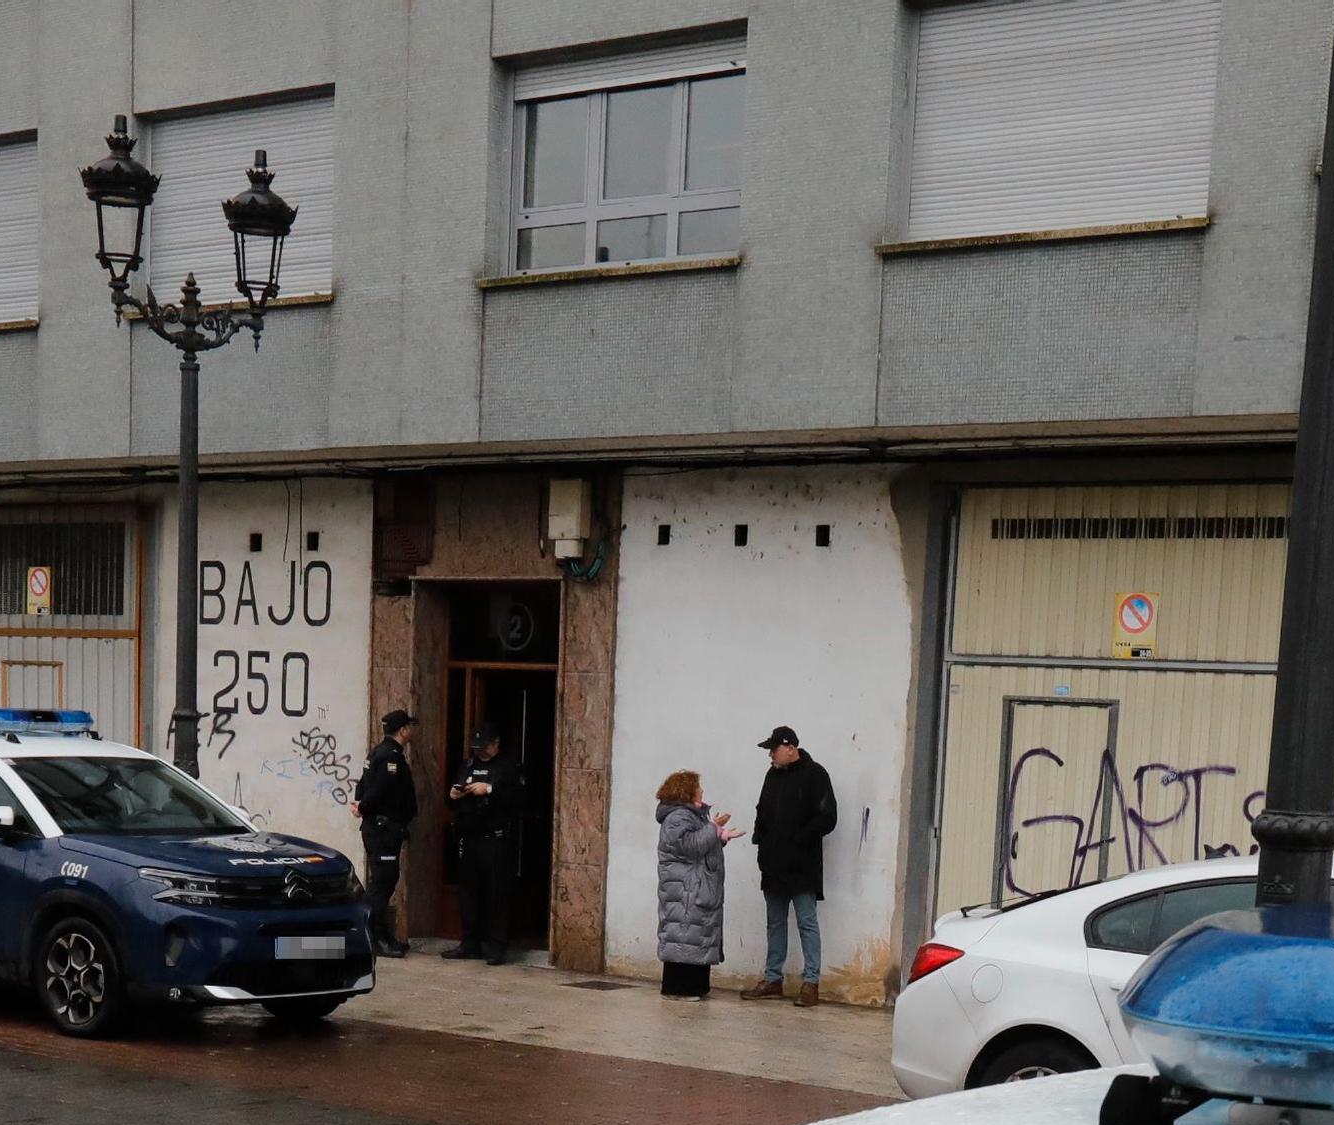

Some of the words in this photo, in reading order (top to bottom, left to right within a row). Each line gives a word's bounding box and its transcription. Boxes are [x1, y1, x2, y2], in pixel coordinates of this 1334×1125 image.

[199, 560, 332, 627] BAJO
[509, 615, 522, 639] 2
[213, 650, 309, 717] 250
[66, 861, 89, 879] 091
